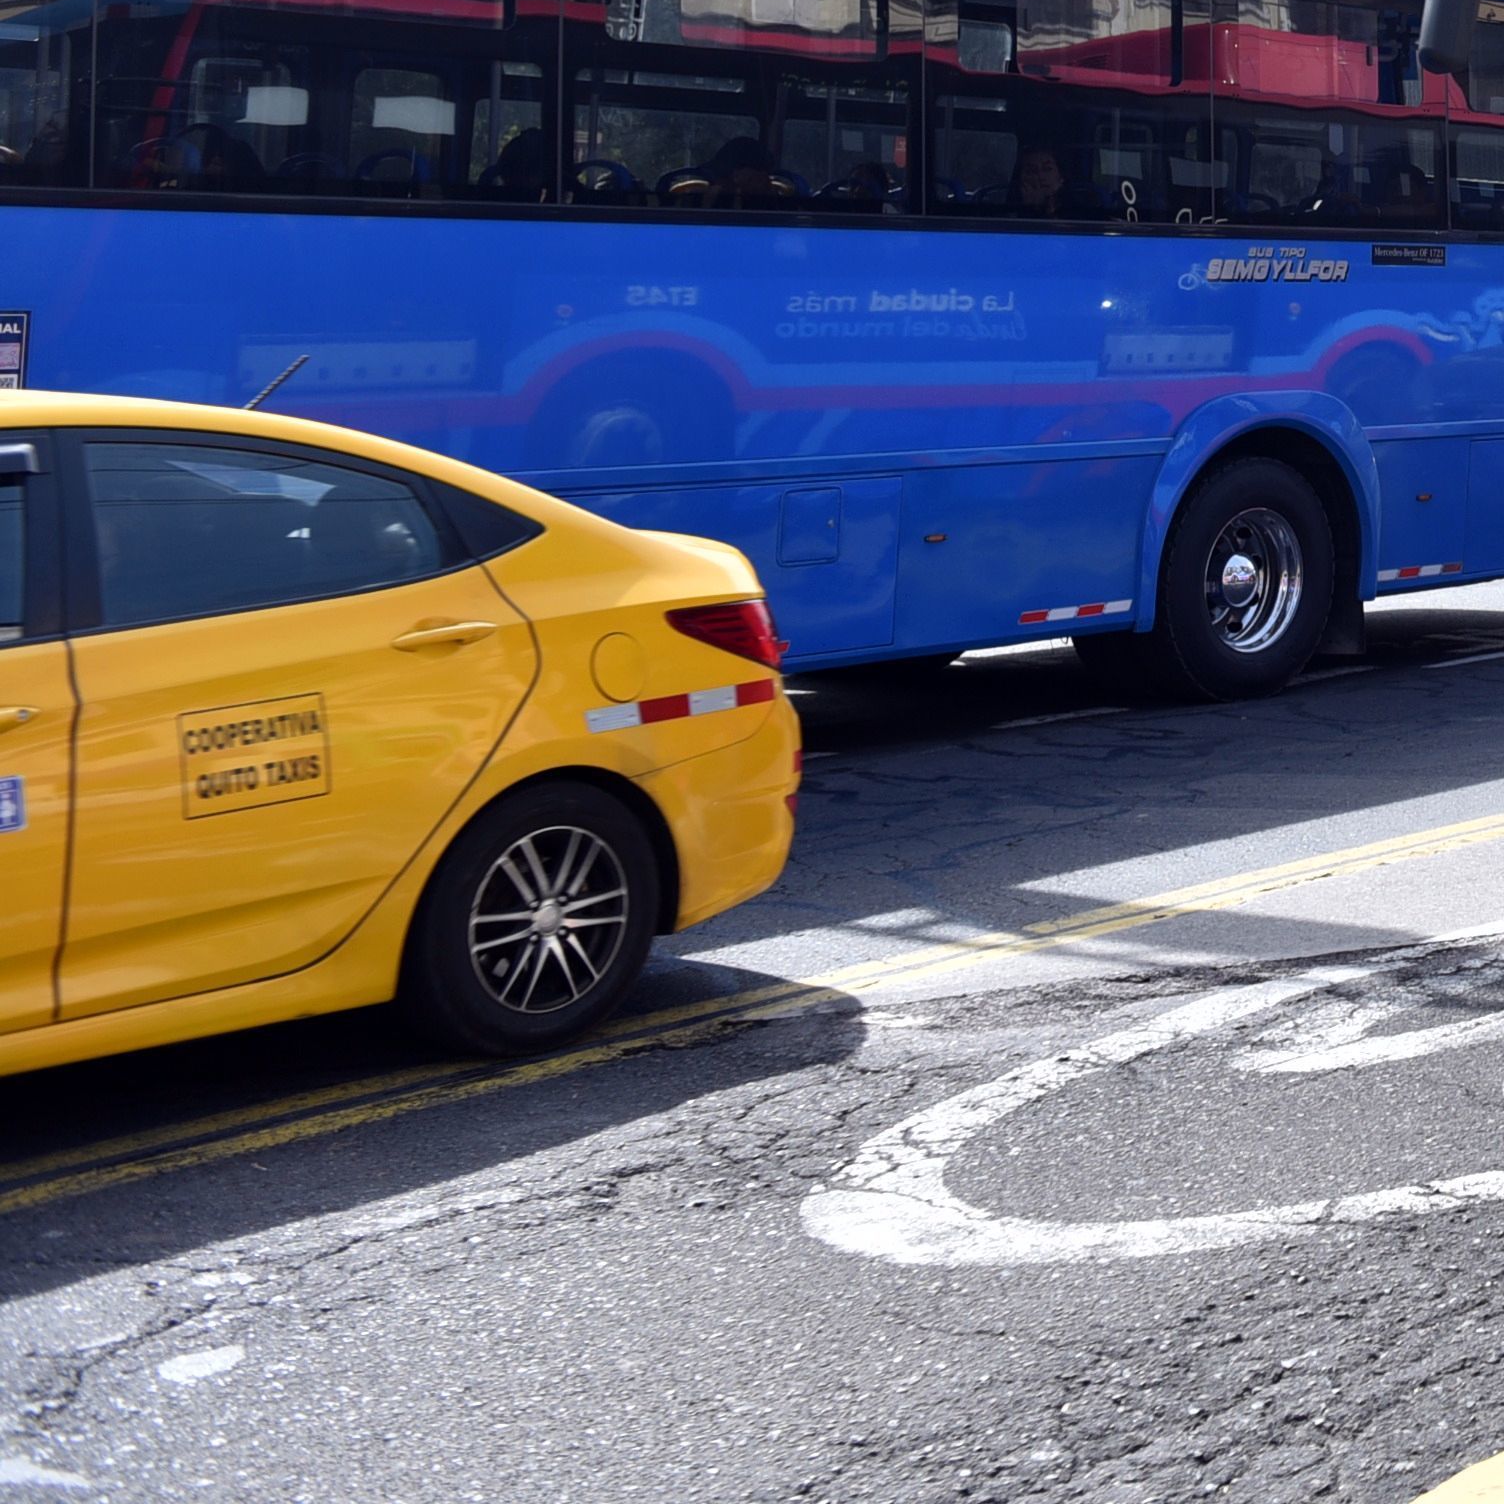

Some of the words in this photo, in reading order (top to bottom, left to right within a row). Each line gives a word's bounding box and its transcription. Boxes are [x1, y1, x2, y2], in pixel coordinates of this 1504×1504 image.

[1248, 248, 1274, 257] BUS
[1280, 248, 1306, 257] TIPO
[1374, 247, 1419, 257] Mercedes-Benz
[184, 710, 322, 755] COOPERATIVA
[196, 765, 260, 799] QUITO
[264, 754, 321, 787] TAXIS
